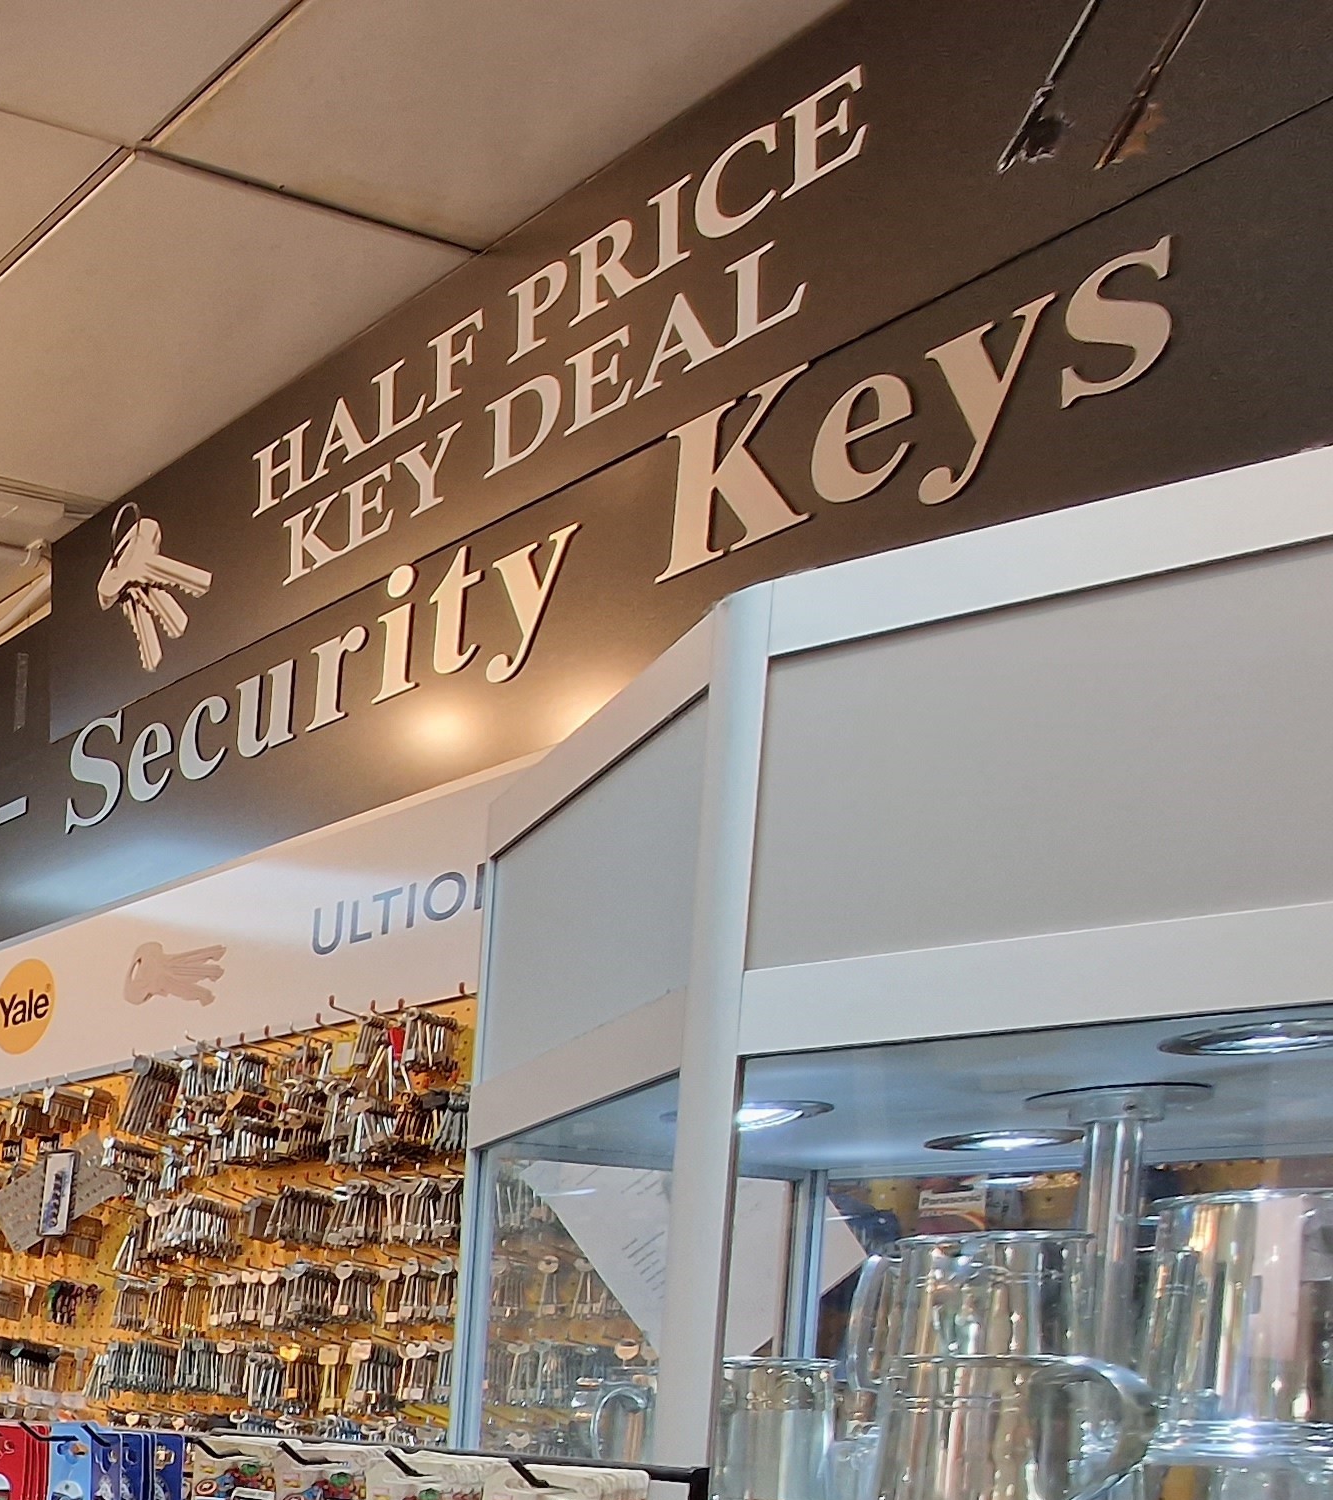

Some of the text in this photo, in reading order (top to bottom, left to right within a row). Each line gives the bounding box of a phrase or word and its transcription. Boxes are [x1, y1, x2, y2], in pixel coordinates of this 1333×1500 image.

[251, 64, 869, 519] HALF PRICE
[282, 240, 809, 587] KEY DEAL
[65, 519, 583, 836] Security
[655, 234, 1175, 587] Keys
